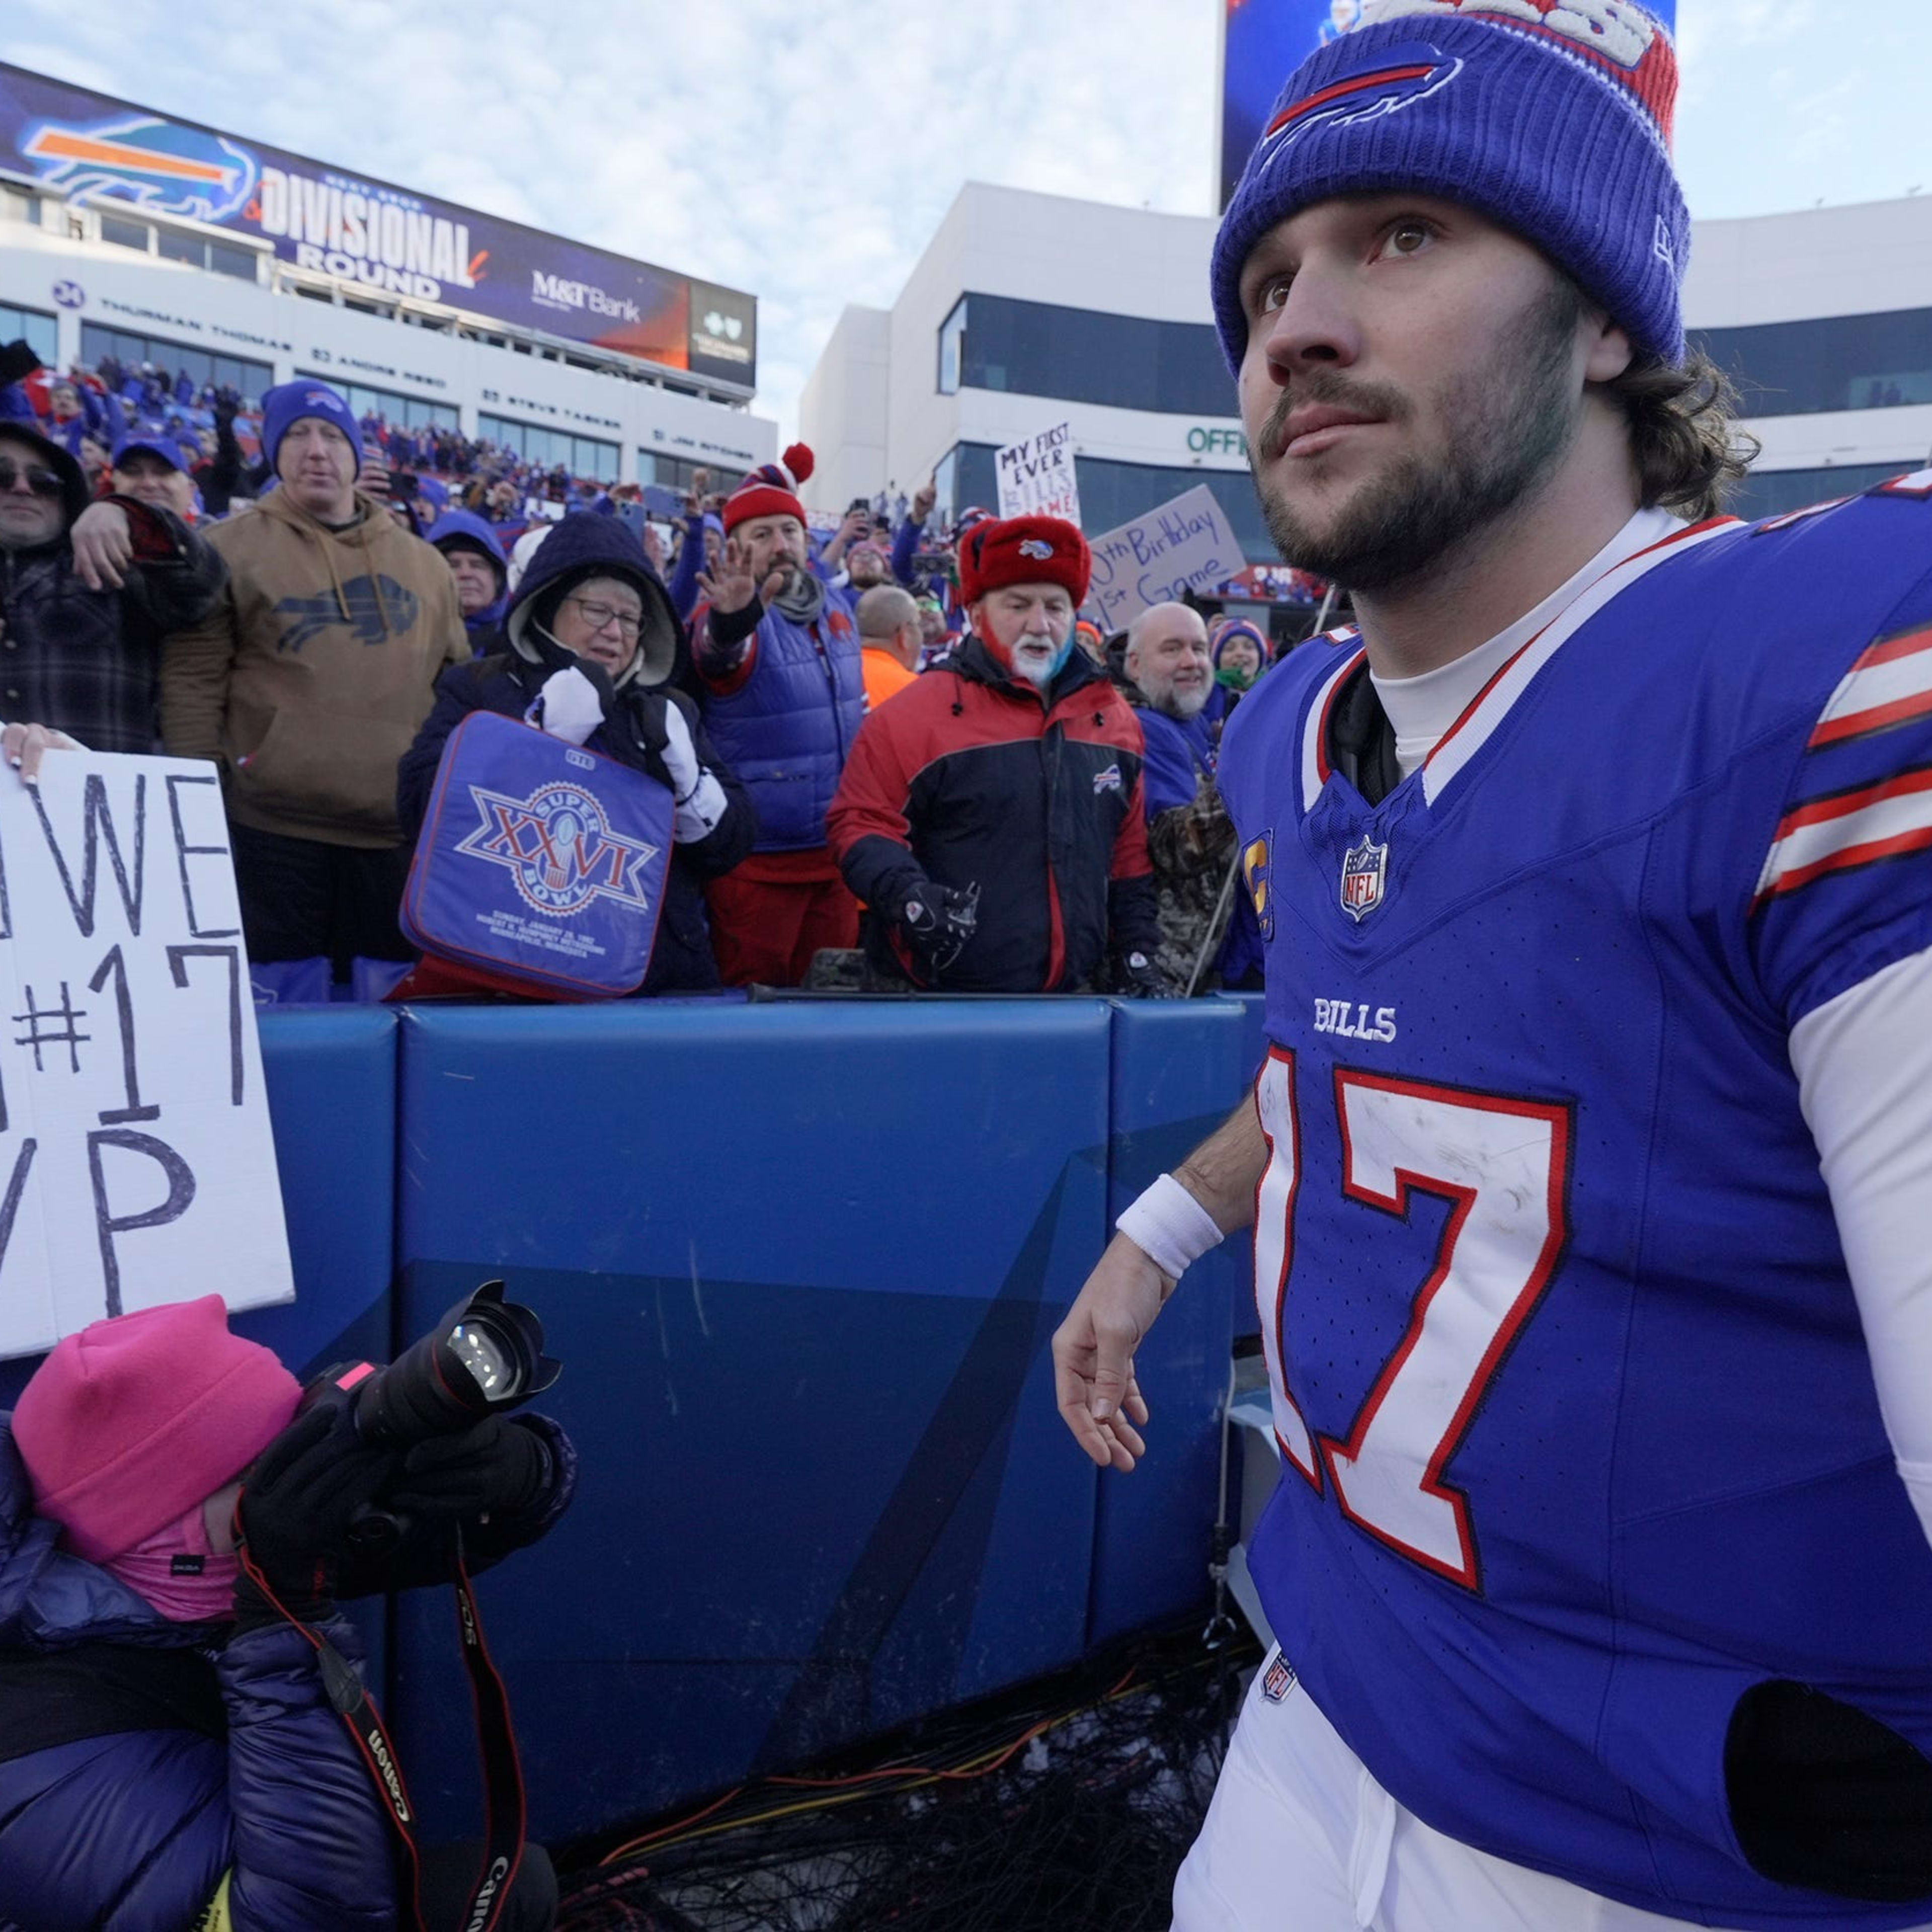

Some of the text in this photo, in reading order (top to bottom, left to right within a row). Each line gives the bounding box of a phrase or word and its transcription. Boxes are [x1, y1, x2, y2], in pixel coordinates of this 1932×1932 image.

[261, 167, 475, 289] DIVISIONAL
[296, 243, 441, 301] ROUND
[1001, 422, 1068, 470] MY FIRST
[1014, 449, 1063, 486] EVER
[1024, 494, 1073, 517] AME
[1126, 511, 1220, 567] Birthday
[1137, 558, 1230, 606] Game
[535, 793, 599, 833] SUPER
[482, 804, 631, 891] XXVI
[524, 868, 587, 905] BOWL
[1345, 874, 1375, 906] NFL
[12, 944, 243, 1125] #17
[1314, 998, 1397, 1043] BILLS
[1254, 1041, 1578, 1599] 17
[1265, 1661, 1289, 1696] NFL
[368, 1729, 410, 1822] Canon
